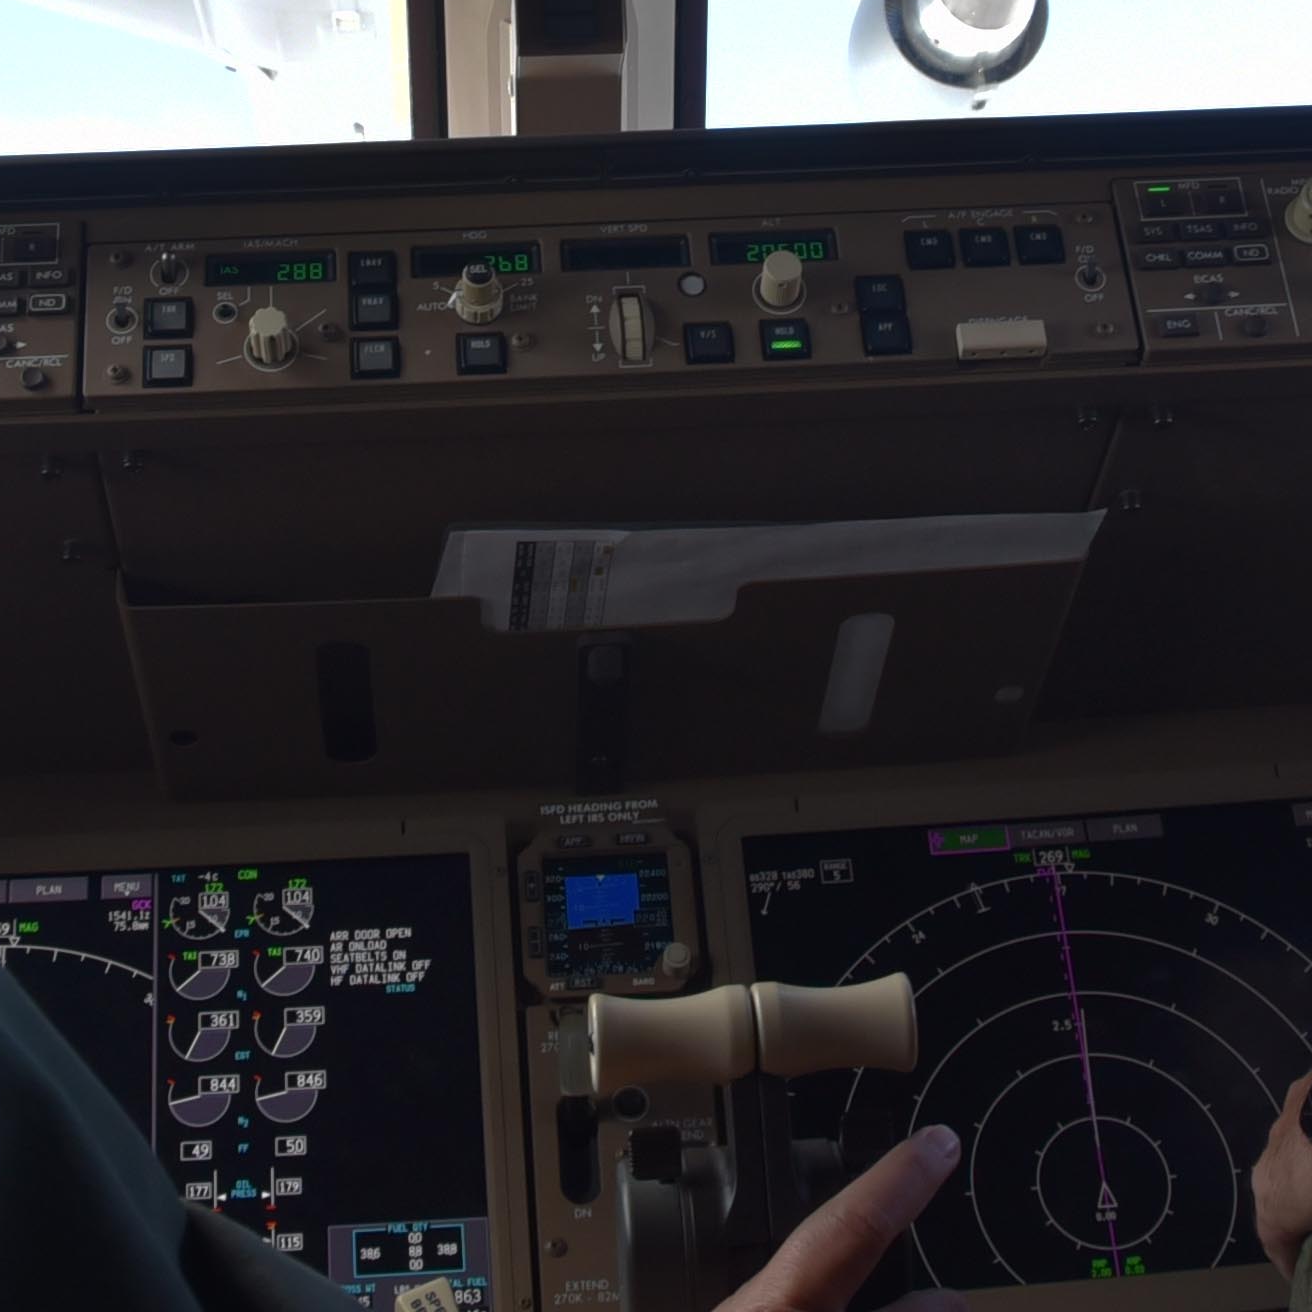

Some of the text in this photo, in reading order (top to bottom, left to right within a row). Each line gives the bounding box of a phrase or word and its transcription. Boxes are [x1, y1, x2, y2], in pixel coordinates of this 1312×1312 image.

[1188, 251, 1223, 259] COMM
[36, 271, 62, 279] INFO
[276, 263, 323, 281] 288
[1085, 294, 1104, 303] OFF
[1166, 320, 1191, 329] ENG
[540, 799, 658, 815] ISFD HEADING FROM
[559, 811, 640, 825] LEFT IRS ONLY
[1113, 823, 1138, 834] PLAN
[960, 834, 978, 844] MAP
[1039, 850, 1063, 864] 269
[36, 885, 63, 896] PLAN
[114, 882, 140, 892] MENU
[19, 922, 39, 933] MAG
[330, 927, 411, 941] ARR DOOR OPEN
[330, 940, 387, 952] AR ONLOAD
[330, 950, 406, 964] SEATBELTS ON
[330, 960, 431, 974] VHF DATALINK OFF
[330, 971, 425, 986] HF DATALINK OFF
[386, 984, 416, 994] STATUS
[210, 1014, 234, 1027] 361
[296, 1010, 321, 1023] 359
[190, 1186, 209, 1197] 177
[231, 1188, 256, 1198] PRESS
[280, 1182, 299, 1193] 179
[574, 1208, 592, 1219] DN
[467, 1278, 487, 1287] FUEL
[565, 1280, 609, 1292] EXTEND
